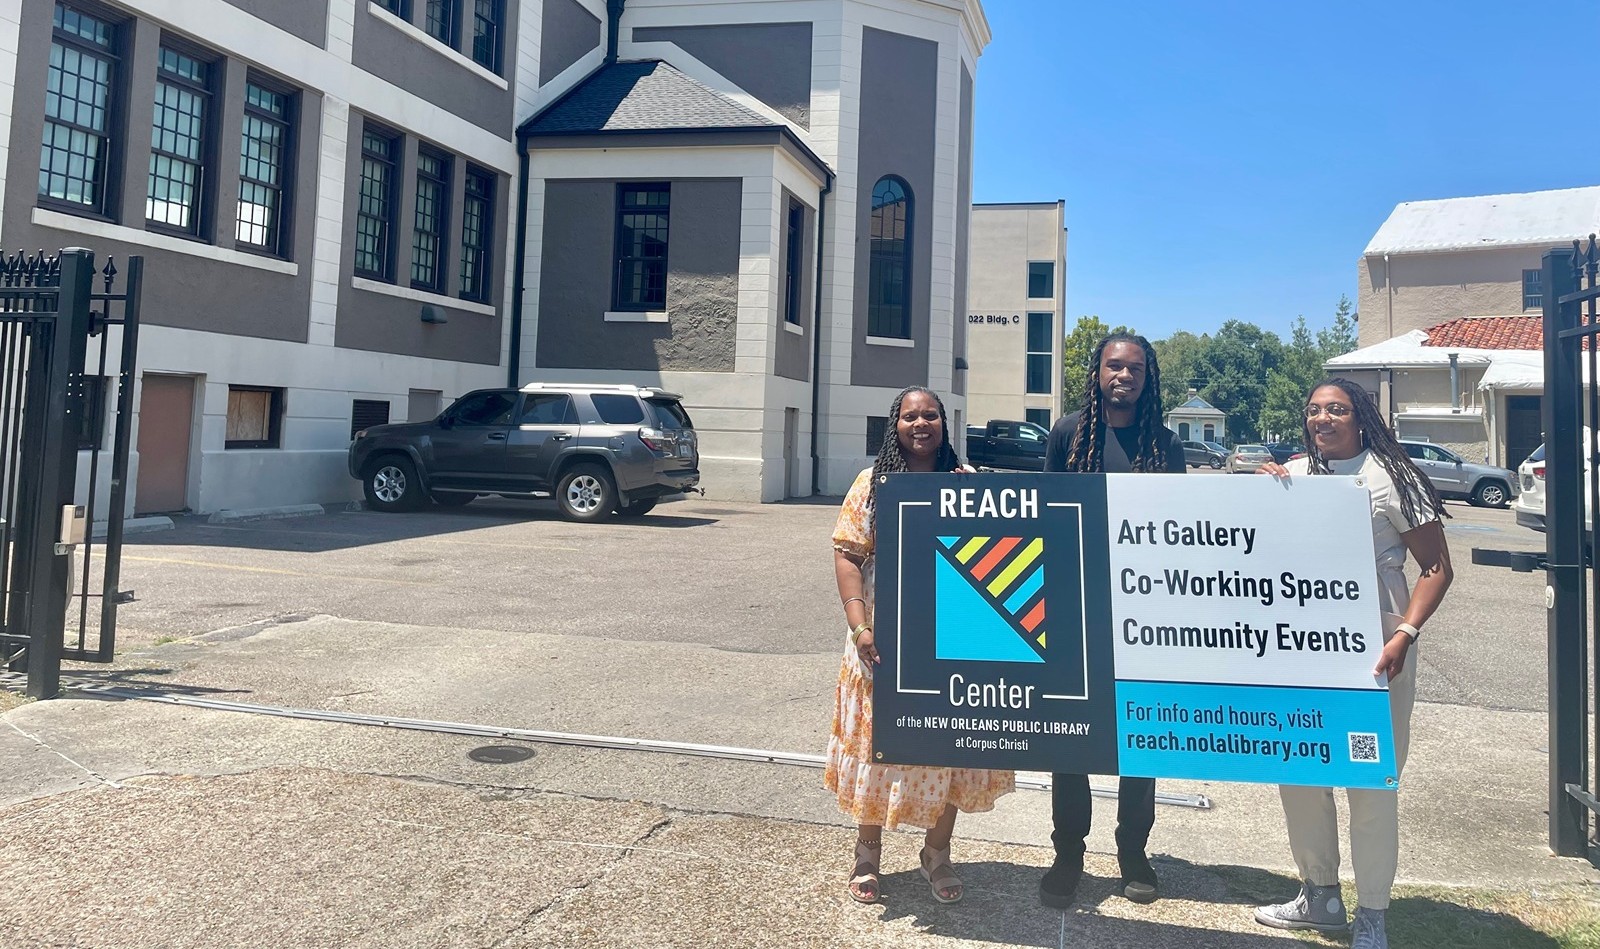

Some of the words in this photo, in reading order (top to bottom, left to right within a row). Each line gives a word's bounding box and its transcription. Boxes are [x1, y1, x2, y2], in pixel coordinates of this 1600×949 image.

[986, 315, 1010, 325] Bldg.
[1012, 315, 1020, 323] C
[940, 488, 1038, 518] REACH
[1117, 519, 1157, 545] Art
[1163, 519, 1256, 554] Gallery
[1121, 567, 1274, 606] Co-Working
[1280, 571, 1360, 607] Space
[1123, 618, 1269, 657] Community
[1276, 622, 1366, 653] Events
[949, 673, 1035, 709] Center
[896, 716, 906, 728] of
[907, 716, 922, 728] the
[924, 717, 948, 729] NEW
[951, 718, 1000, 732] ORLEANS
[1002, 720, 1041, 734] PUBLIC
[1043, 722, 1090, 735] LIBRARY
[1126, 701, 1152, 721] For
[1157, 702, 1188, 723] info
[1193, 705, 1224, 725] and
[1229, 706, 1283, 731] hours,
[1287, 708, 1324, 729] visit
[955, 738, 964, 748] at
[966, 737, 997, 751] Corpus
[999, 738, 1028, 751] Christi
[1127, 731, 1331, 764] reach.nolalibrary.org
